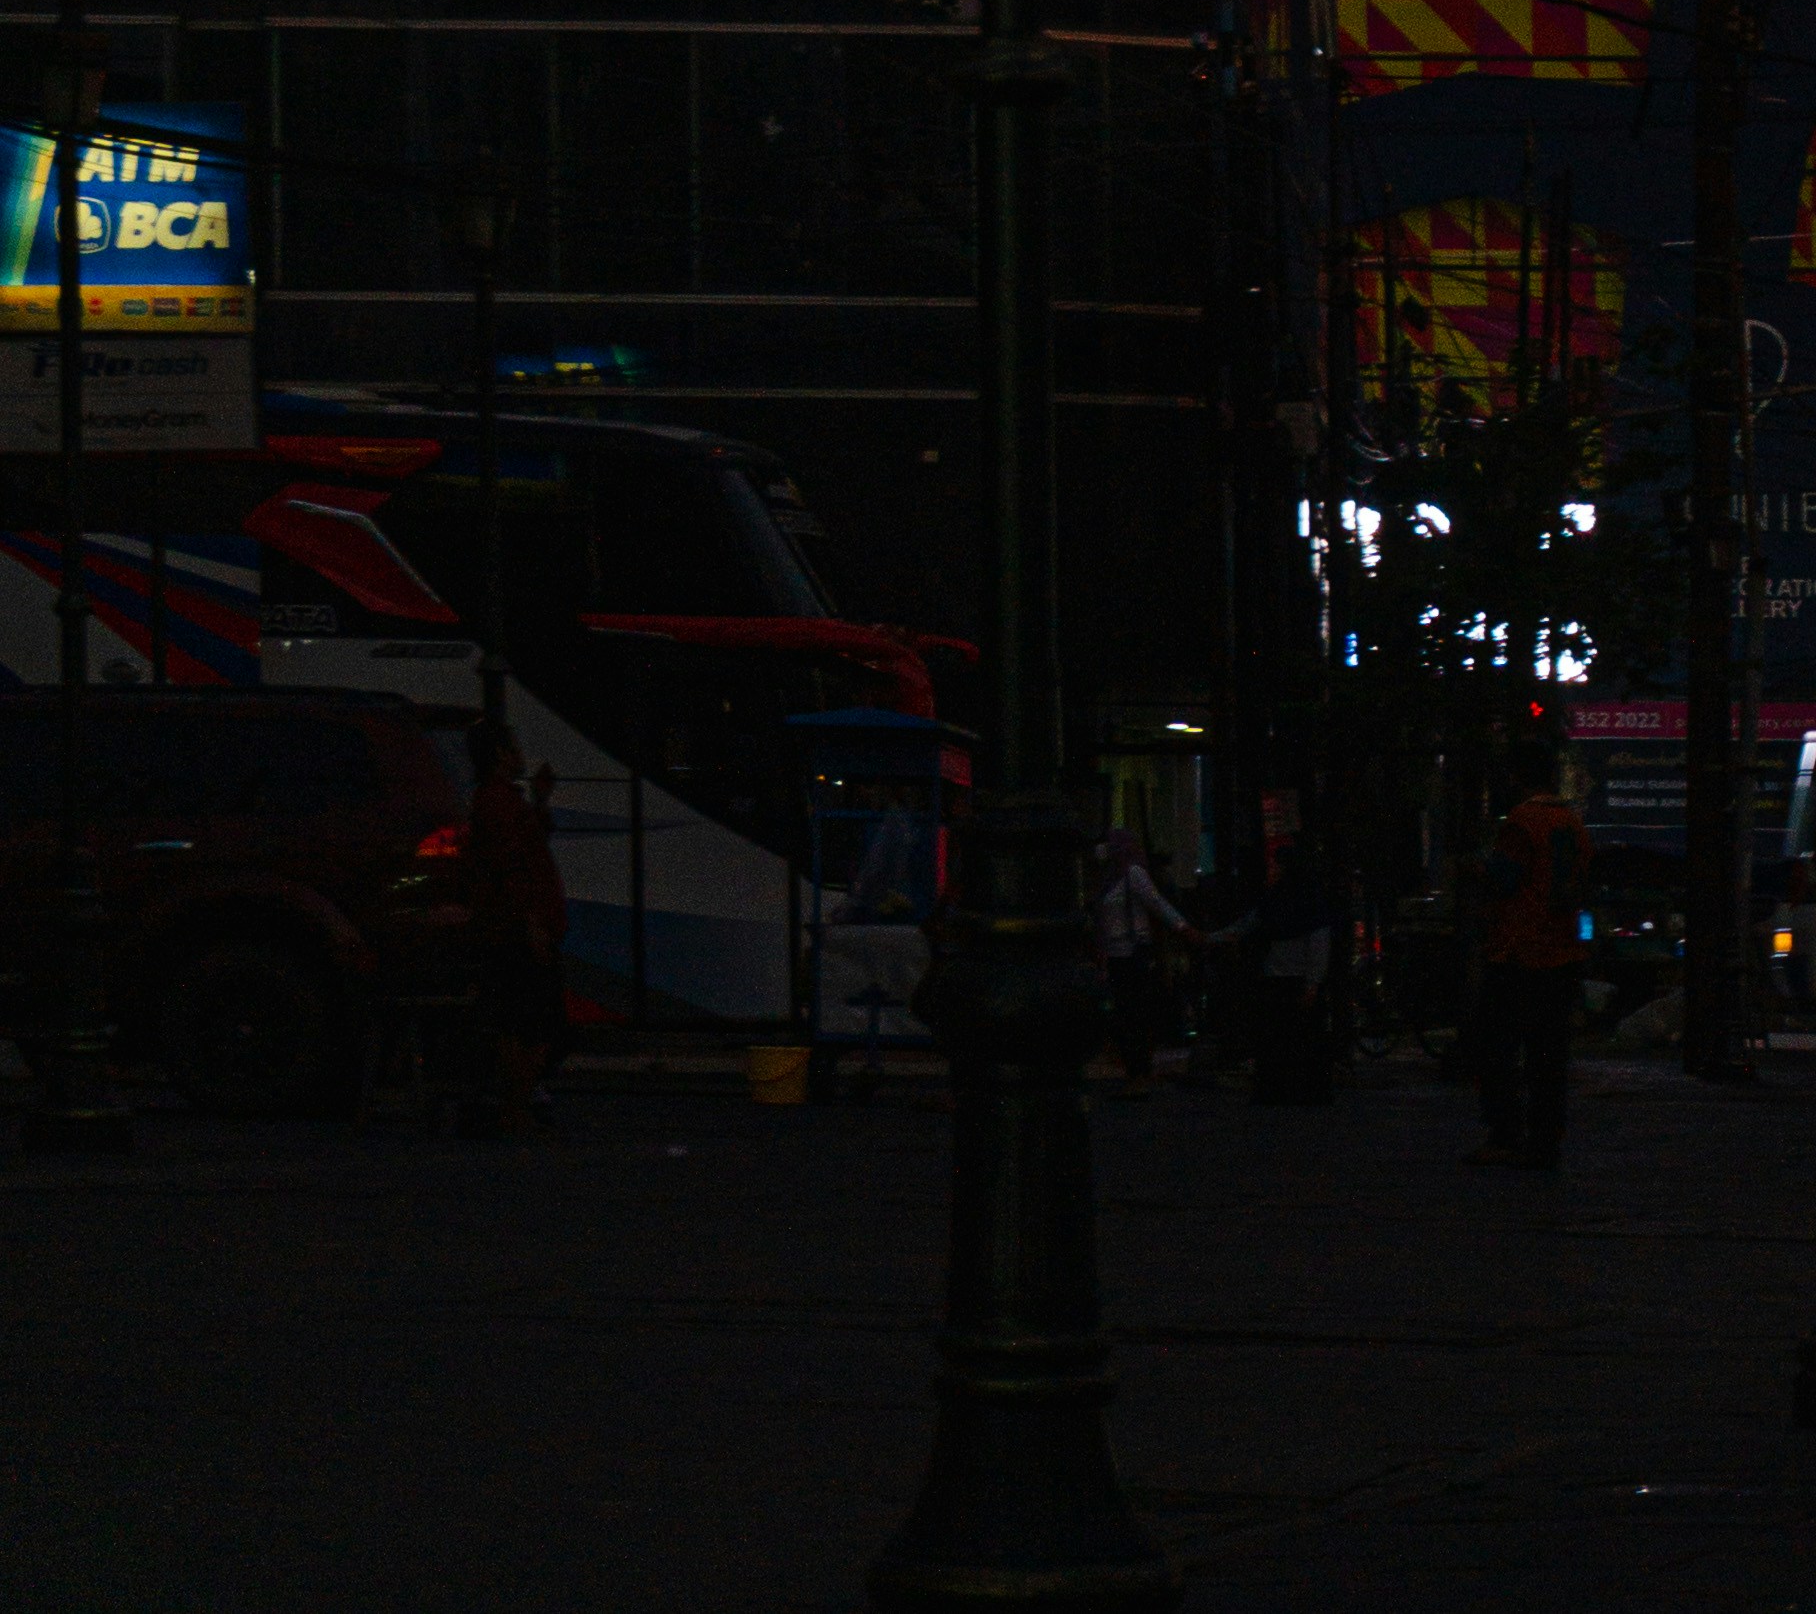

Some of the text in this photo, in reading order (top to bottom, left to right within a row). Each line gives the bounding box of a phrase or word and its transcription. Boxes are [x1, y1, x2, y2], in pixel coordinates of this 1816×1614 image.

[77, 135, 200, 183] ATM
[115, 201, 230, 250] BCA
[1574, 711, 1610, 729] 352
[1614, 710, 1661, 729] 2022
